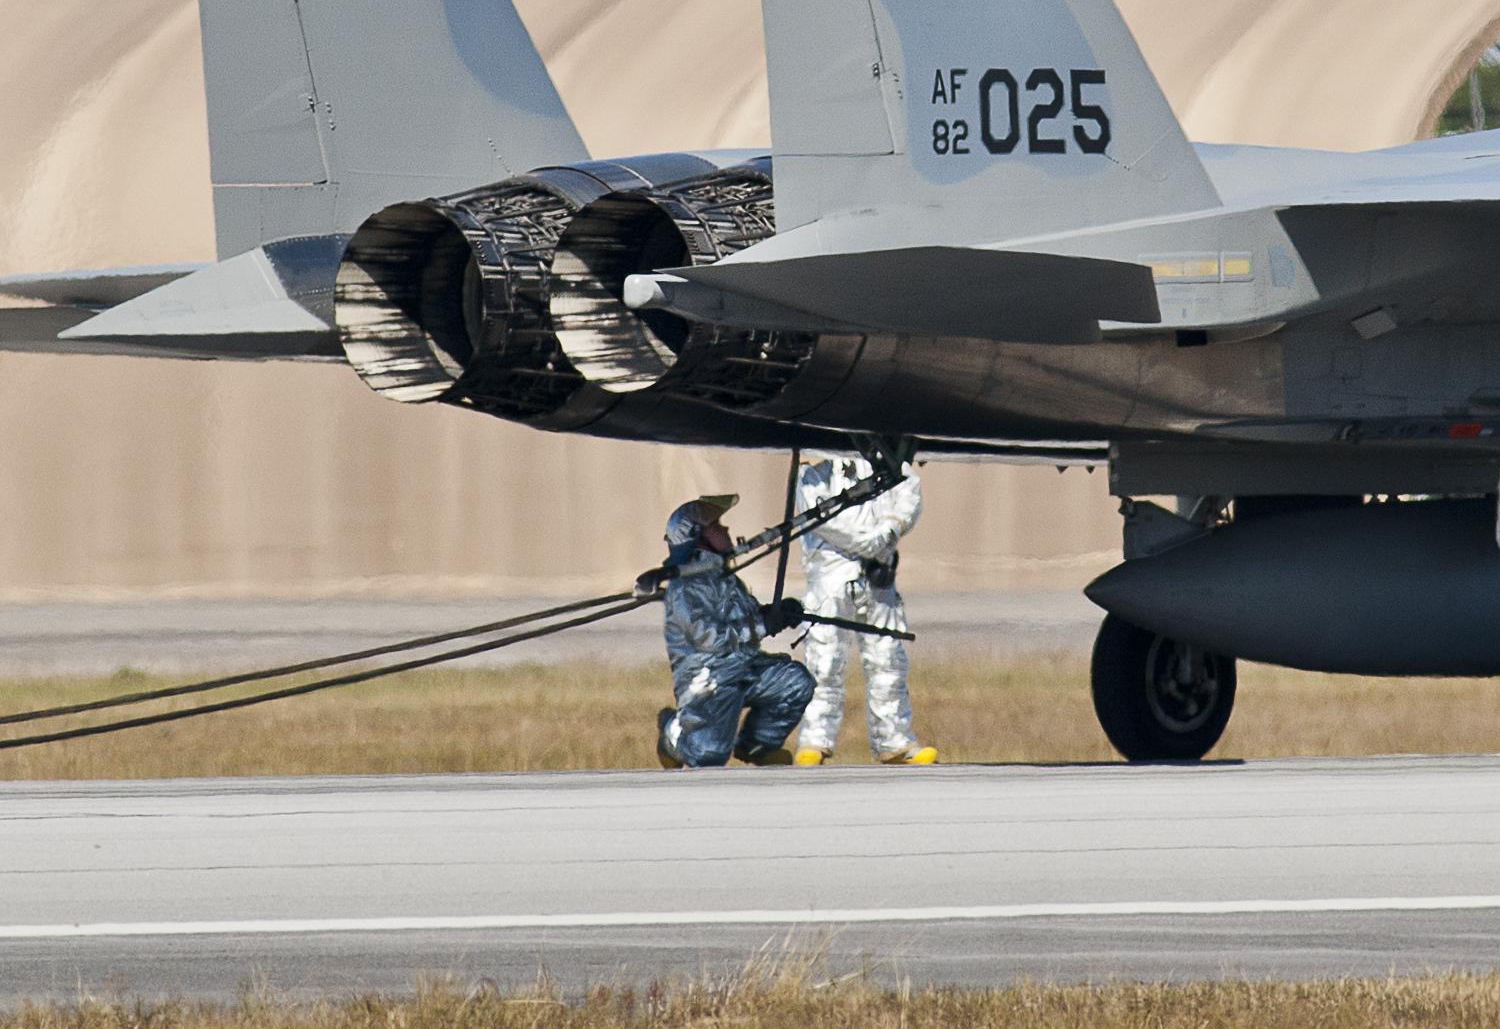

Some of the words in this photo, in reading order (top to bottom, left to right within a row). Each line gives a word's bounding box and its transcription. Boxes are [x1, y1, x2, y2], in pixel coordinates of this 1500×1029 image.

[931, 69, 968, 104] AF
[978, 68, 1111, 154] 025
[931, 119, 969, 154] 82
